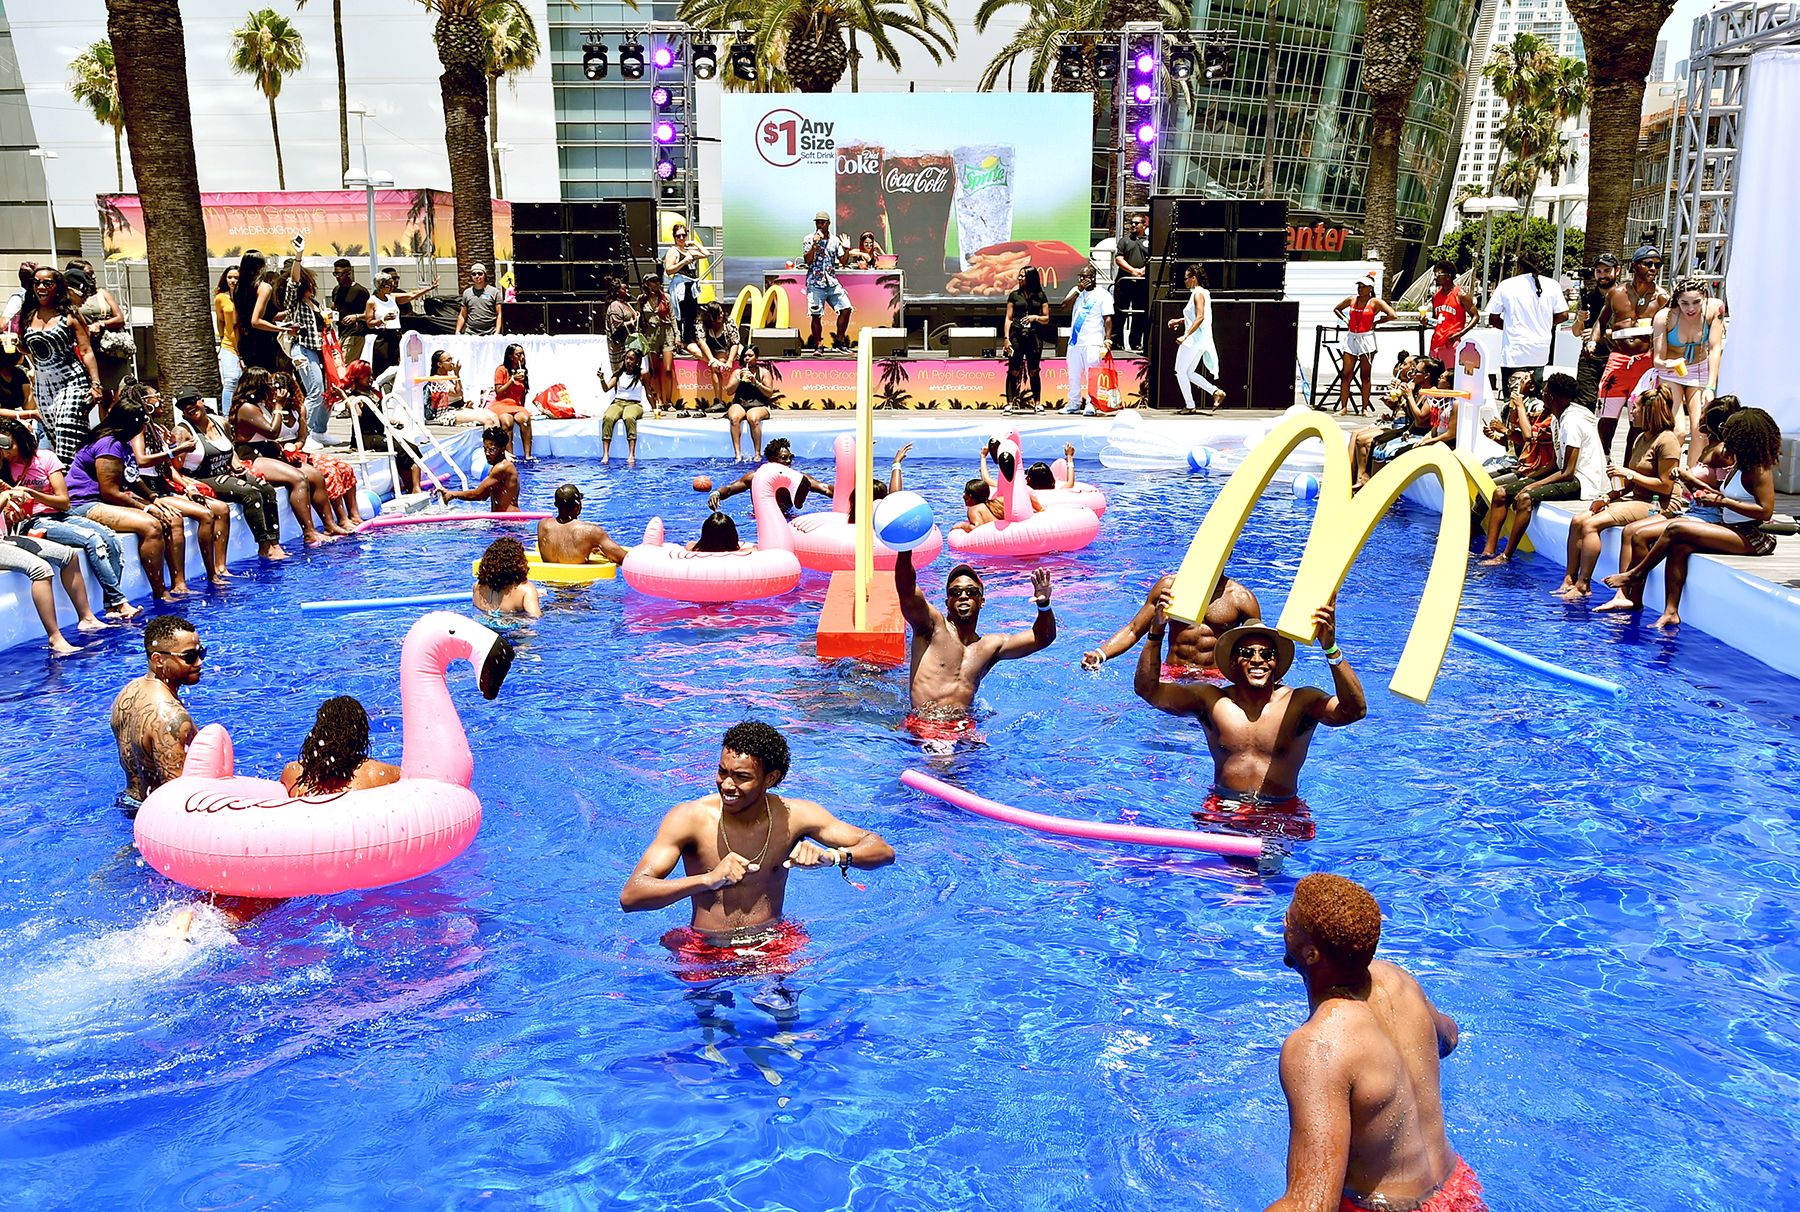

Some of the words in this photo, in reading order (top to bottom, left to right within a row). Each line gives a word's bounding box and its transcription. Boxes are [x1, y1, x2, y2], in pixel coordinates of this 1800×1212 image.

[800, 118, 835, 137] Any
[763, 120, 796, 156] $1
[800, 135, 835, 150] Size
[800, 151, 816, 160] Soft
[816, 151, 835, 159] Drink
[862, 150, 879, 161] Diet
[836, 154, 880, 175] Coke
[885, 167, 949, 194] Coca-Cola
[964, 163, 1006, 190] Sprite
[223, 206, 262, 220] Pool
[263, 206, 327, 221] Groove
[805, 369, 828, 380] Pool
[829, 369, 857, 380] Groo
[931, 369, 954, 380] Pool
[956, 369, 996, 380] Groove
